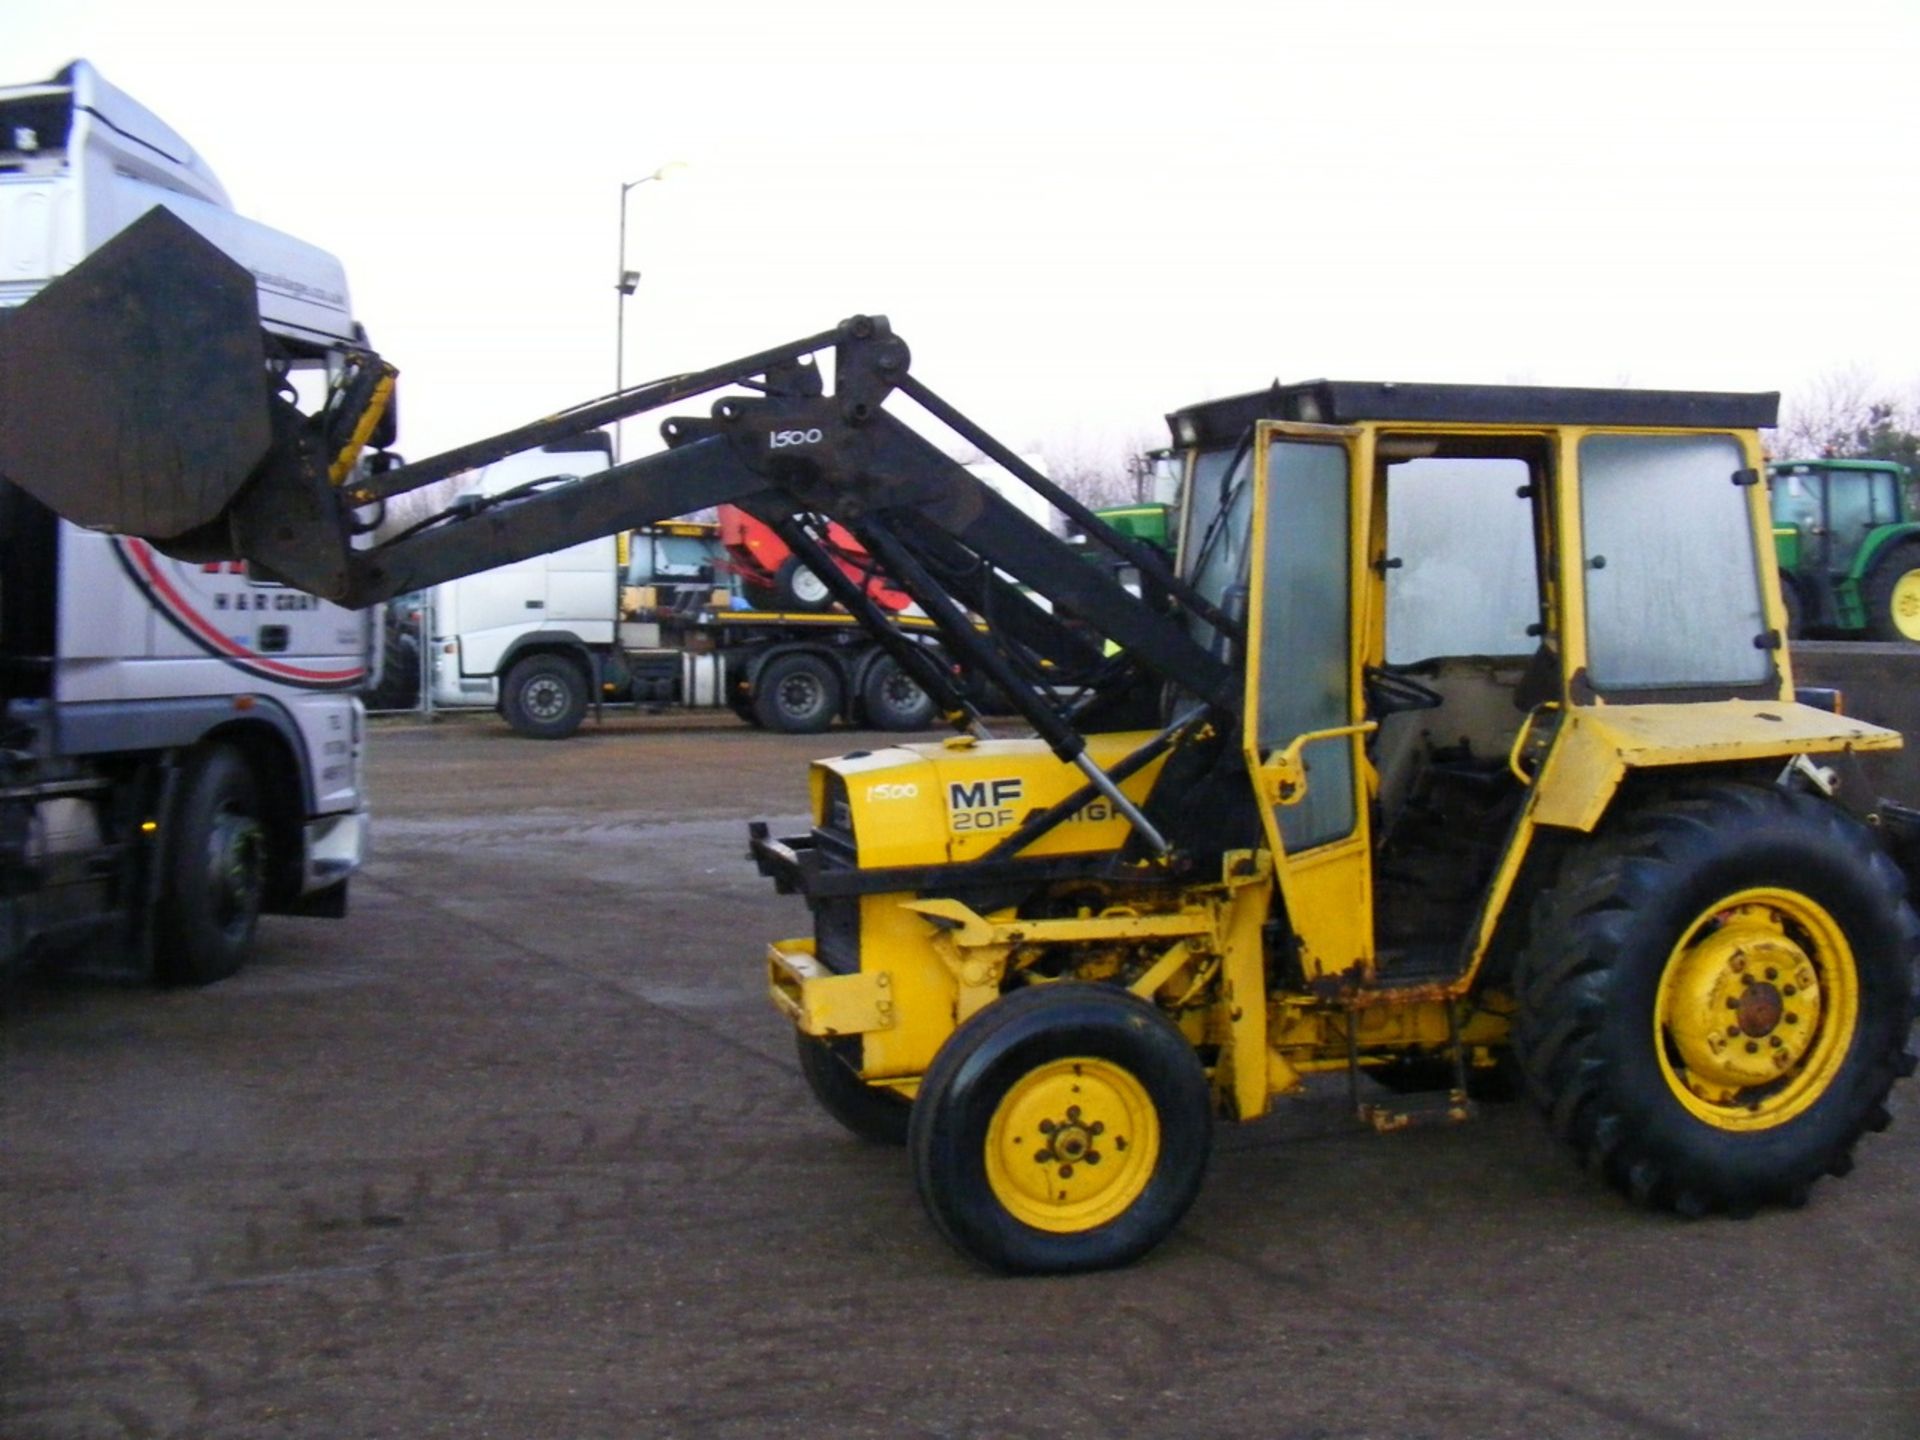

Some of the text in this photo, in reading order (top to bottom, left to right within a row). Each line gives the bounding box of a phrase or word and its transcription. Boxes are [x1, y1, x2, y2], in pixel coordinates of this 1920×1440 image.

[770, 428, 822, 448] 1500
[867, 783, 917, 802] 1500
[950, 779, 1021, 809] MF
[953, 810, 1013, 830] 20F
